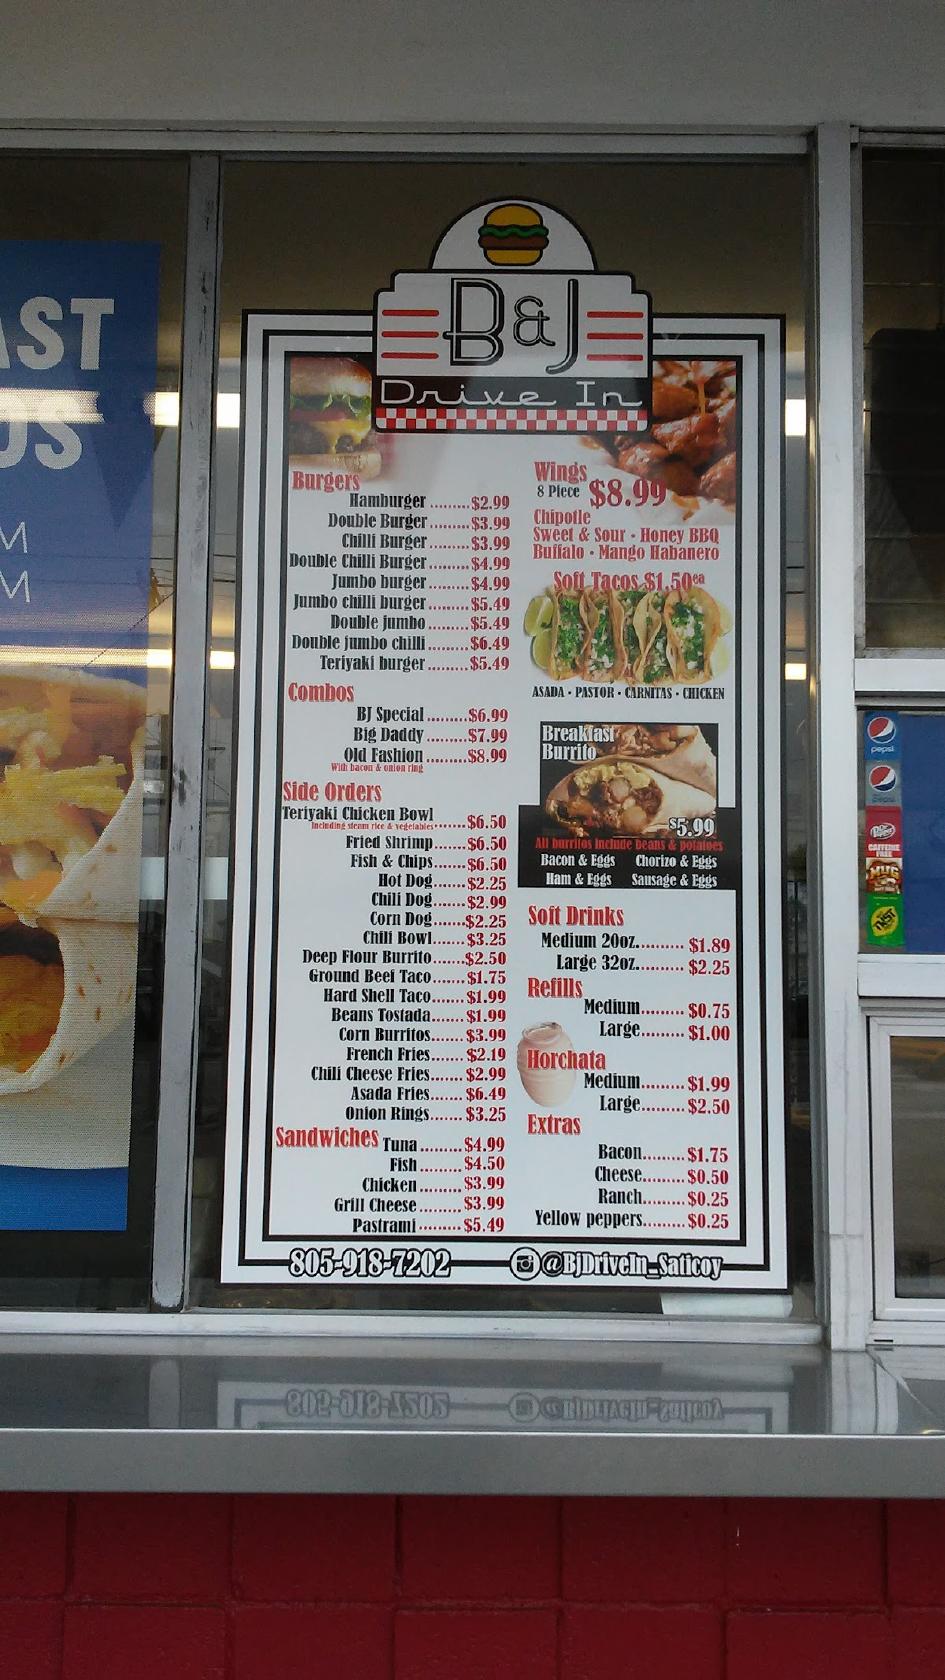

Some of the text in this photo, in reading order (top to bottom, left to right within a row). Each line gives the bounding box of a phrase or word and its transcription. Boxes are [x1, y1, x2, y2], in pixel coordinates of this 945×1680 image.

[0, 296, 115, 370] ST
[442, 278, 579, 375] B&J
[381, 380, 643, 407] Drive In
[292, 471, 360, 492] Burgers
[534, 461, 587, 484] Wings
[537, 485, 580, 498] 8 Piece
[588, 478, 667, 509] $8.99
[349, 493, 510, 511] Hamburger $2.99
[328, 513, 510, 531] Double Burger $3.99
[534, 509, 591, 526] Chipotle
[533, 528, 719, 545] Sweet & Sour Honey BBQ
[533, 544, 719, 561] Buffalo Mango Habanero
[289, 554, 510, 571] Double Chilli Burger $4.99
[554, 571, 585, 591] Soft
[591, 572, 639, 591] Tacos
[293, 594, 510, 612] Jumbo chilli burger $5.49
[292, 635, 510, 651] Double jumbo chilli $6.49
[288, 683, 354, 702] Combos
[532, 686, 725, 699] ASADA PASTOR CARNITAS CHICKEN
[357, 707, 508, 723] BJ Special $6.99
[353, 727, 508, 744] Big Daddy $7.99
[542, 725, 615, 742] Breakfast
[344, 748, 507, 763] Old Fashion $8.99
[542, 744, 597, 761] Burrito
[331, 763, 424, 773] With bacon & onion ring
[283, 781, 382, 802] Side Orders
[282, 806, 507, 829] Teriyaki Chicken Bowl $6.50
[669, 817, 715, 838] $5.99
[346, 835, 507, 851] Fried Shrimp $6.50
[552, 838, 592, 850] burritos
[595, 838, 632, 850] include
[636, 839, 665, 850] beans
[669, 839, 677, 850] &
[680, 839, 723, 852] potatoes
[350, 854, 507, 872] Fish & Chips $6.50
[541, 854, 615, 868] Bacon & Eggs
[636, 855, 717, 869] Chorizo & Eggs
[632, 874, 717, 888] Sausage & Eggs
[528, 906, 624, 926] Soft Drinks
[542, 933, 596, 948] Medium
[689, 938, 730, 953] $1.89
[303, 950, 507, 966] Deep Flour Burrito $2.50
[557, 954, 597, 972] Large
[689, 959, 730, 975] $2.25
[528, 978, 583, 998] Refills
[332, 1008, 506, 1024] Beans Tostada $1.99
[584, 999, 730, 1019] Medium $0.75
[600, 1021, 730, 1041] Large $1.00
[527, 1050, 606, 1070] Horchata
[351, 1086, 506, 1101] Asada Fries $6.49
[345, 1106, 506, 1122] Onion Rings $3.25
[528, 1114, 581, 1134] Extras
[276, 1127, 379, 1148] Sandwiches
[383, 1137, 505, 1153] Tuna $4.99
[598, 1144, 728, 1162] Bacon $1.75
[390, 1157, 505, 1172] Fish $4.50
[363, 1176, 505, 1192] Chicken $3.99
[595, 1166, 729, 1185] Cheese $0.50
[334, 1196, 505, 1212] Grill Cheese $3.99
[352, 1217, 505, 1233] Pastrami $5.49
[535, 1210, 729, 1229] Yellow peppers $0.25
[289, 1248, 451, 1277] 805-918-7202
